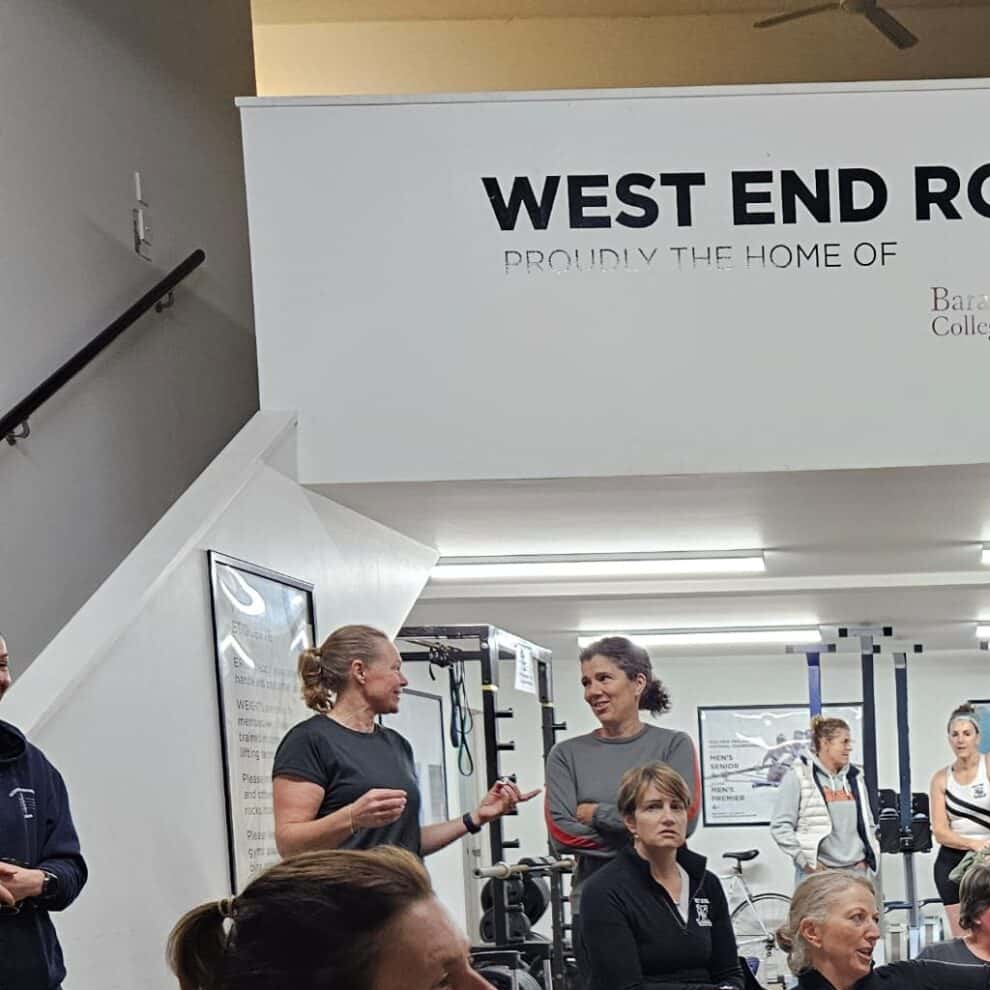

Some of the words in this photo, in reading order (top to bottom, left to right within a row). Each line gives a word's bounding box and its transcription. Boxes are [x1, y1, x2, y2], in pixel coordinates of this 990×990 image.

[481, 172, 706, 231] WEST
[731, 167, 889, 226] END
[504, 248, 658, 274] PROUDLY
[670, 245, 732, 270] THE
[746, 243, 842, 269] HOME
[853, 241, 899, 268] OF
